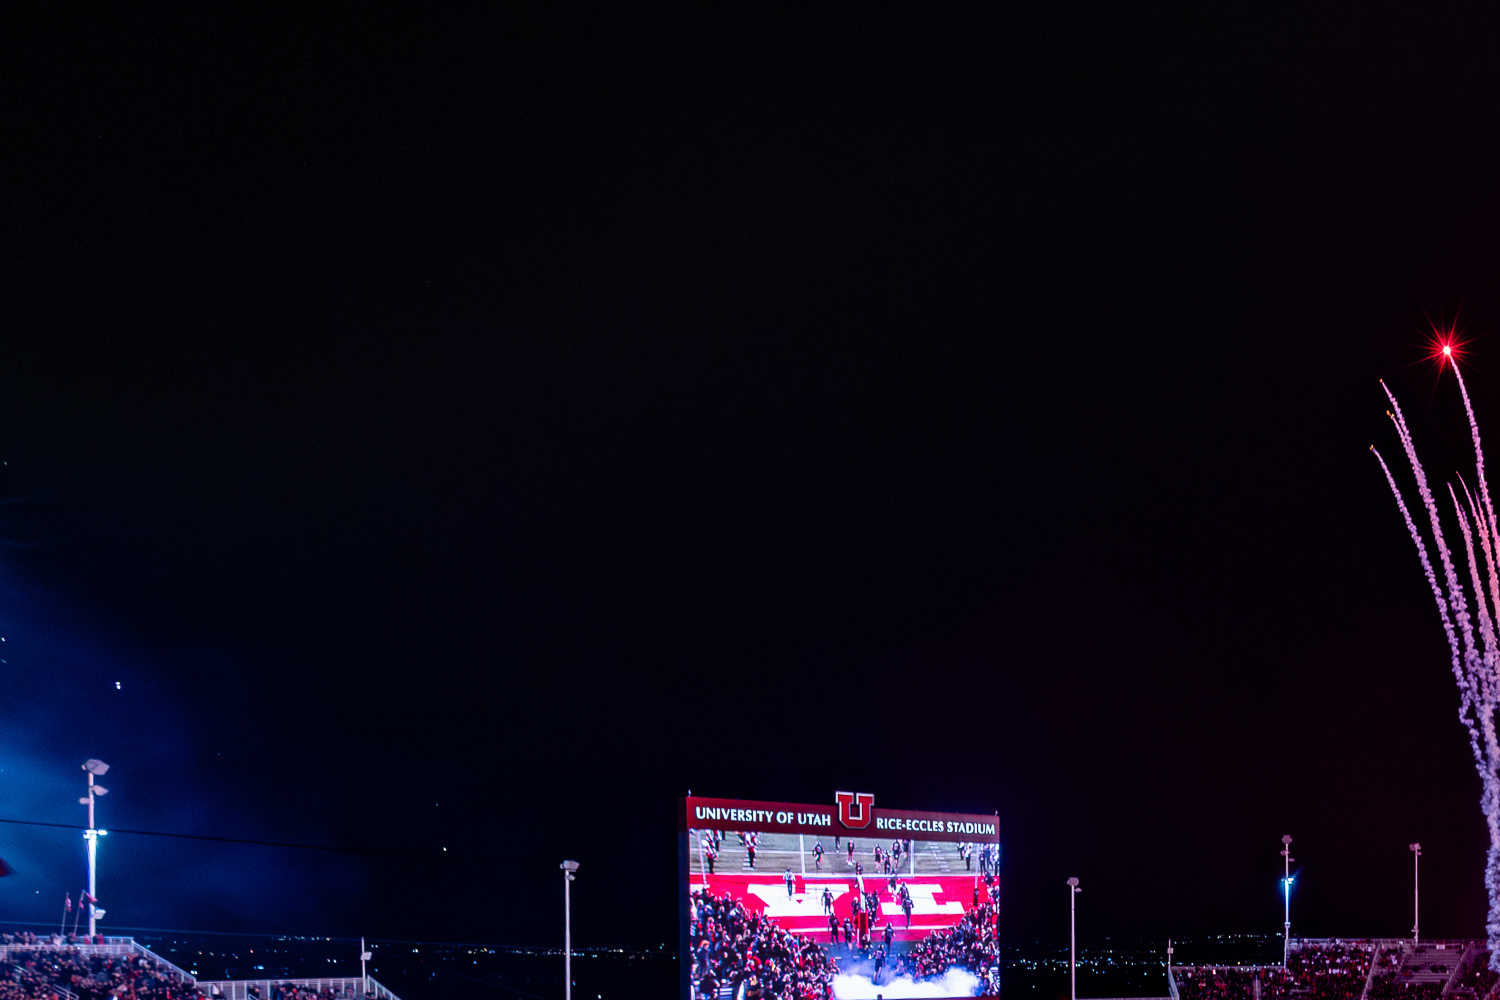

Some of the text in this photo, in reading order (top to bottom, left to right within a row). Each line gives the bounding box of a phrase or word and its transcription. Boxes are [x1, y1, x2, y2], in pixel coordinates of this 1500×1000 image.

[696, 806, 832, 827] UNIVERSITY OF UTAH
[835, 791, 874, 830] U
[876, 818, 996, 836] RICE-ECCLES STADIUM
